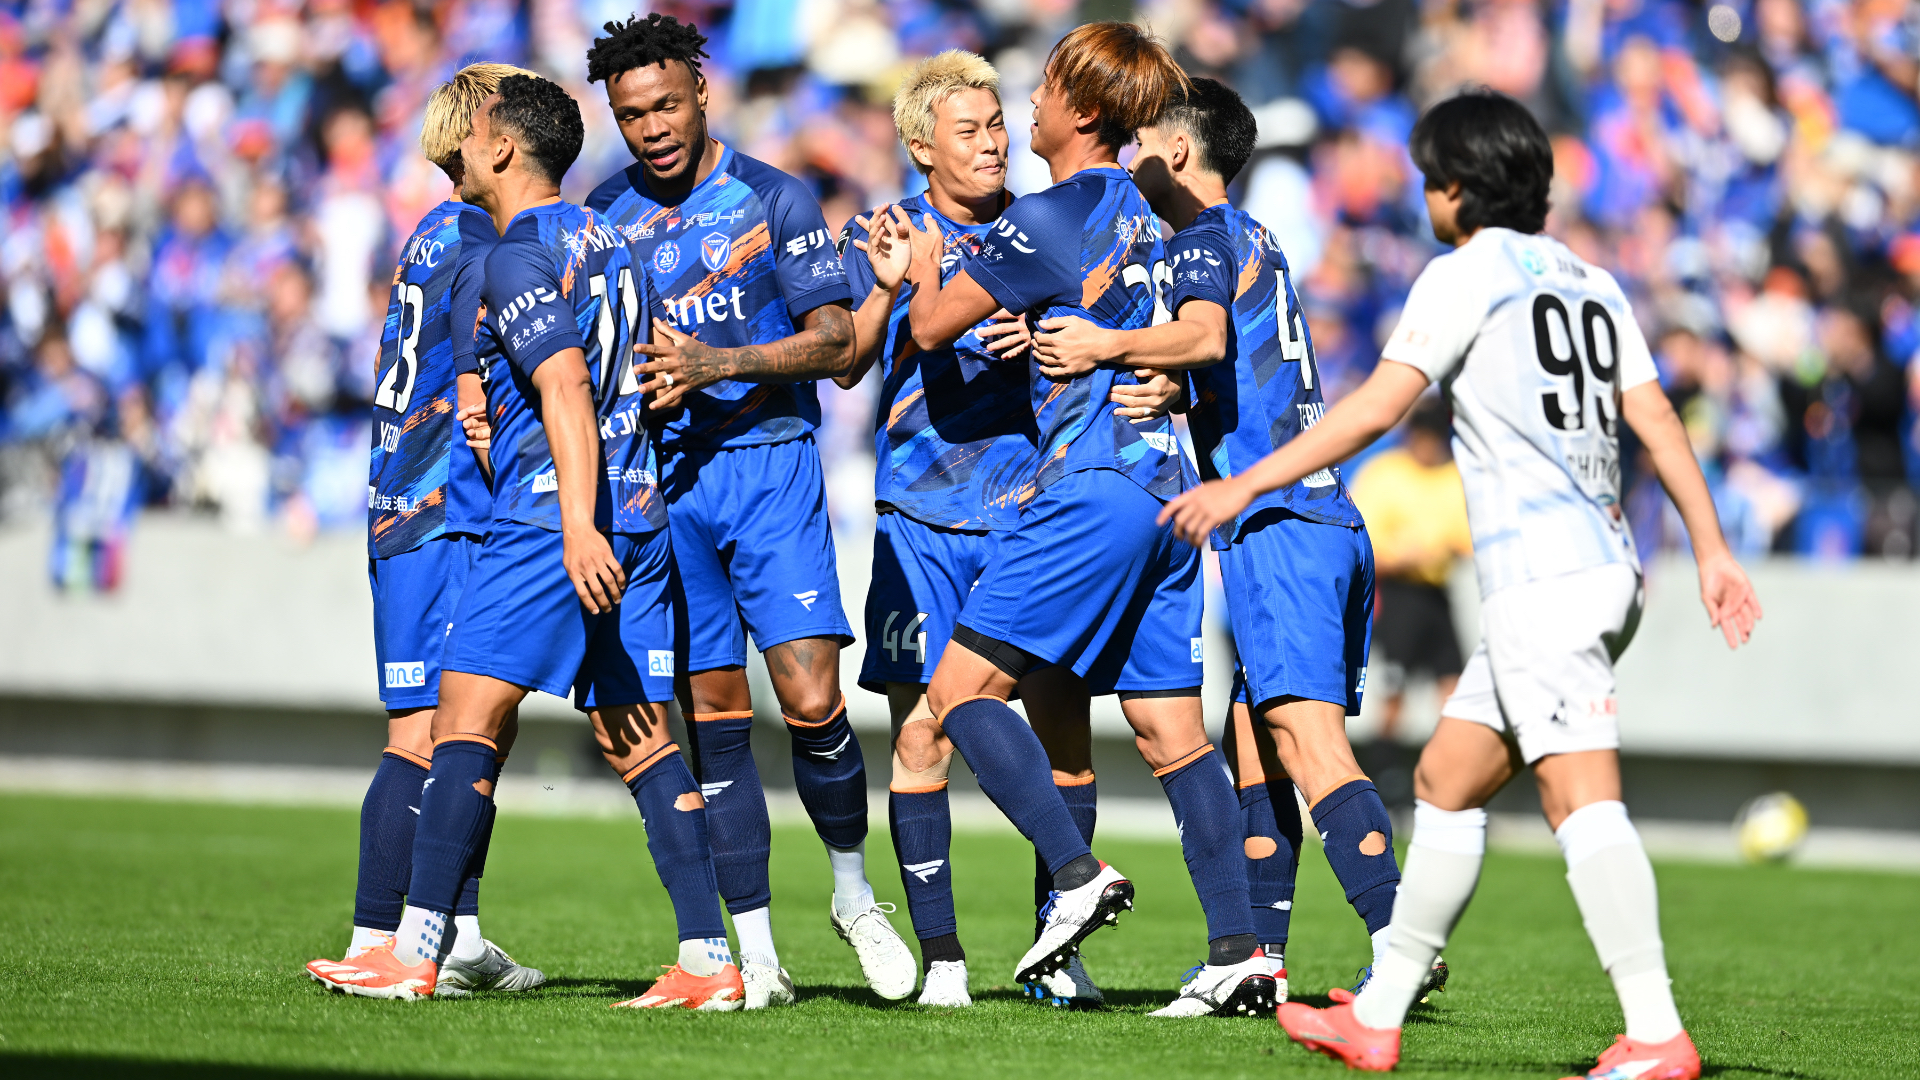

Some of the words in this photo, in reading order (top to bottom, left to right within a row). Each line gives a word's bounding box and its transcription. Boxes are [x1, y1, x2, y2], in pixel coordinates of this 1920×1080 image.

[406, 236, 444, 268] MSC
[660, 250, 674, 263] 20
[374, 280, 424, 414] 23
[511, 314, 556, 351] 正々道々
[1531, 292, 1619, 438] 99
[882, 610, 930, 664] 44
